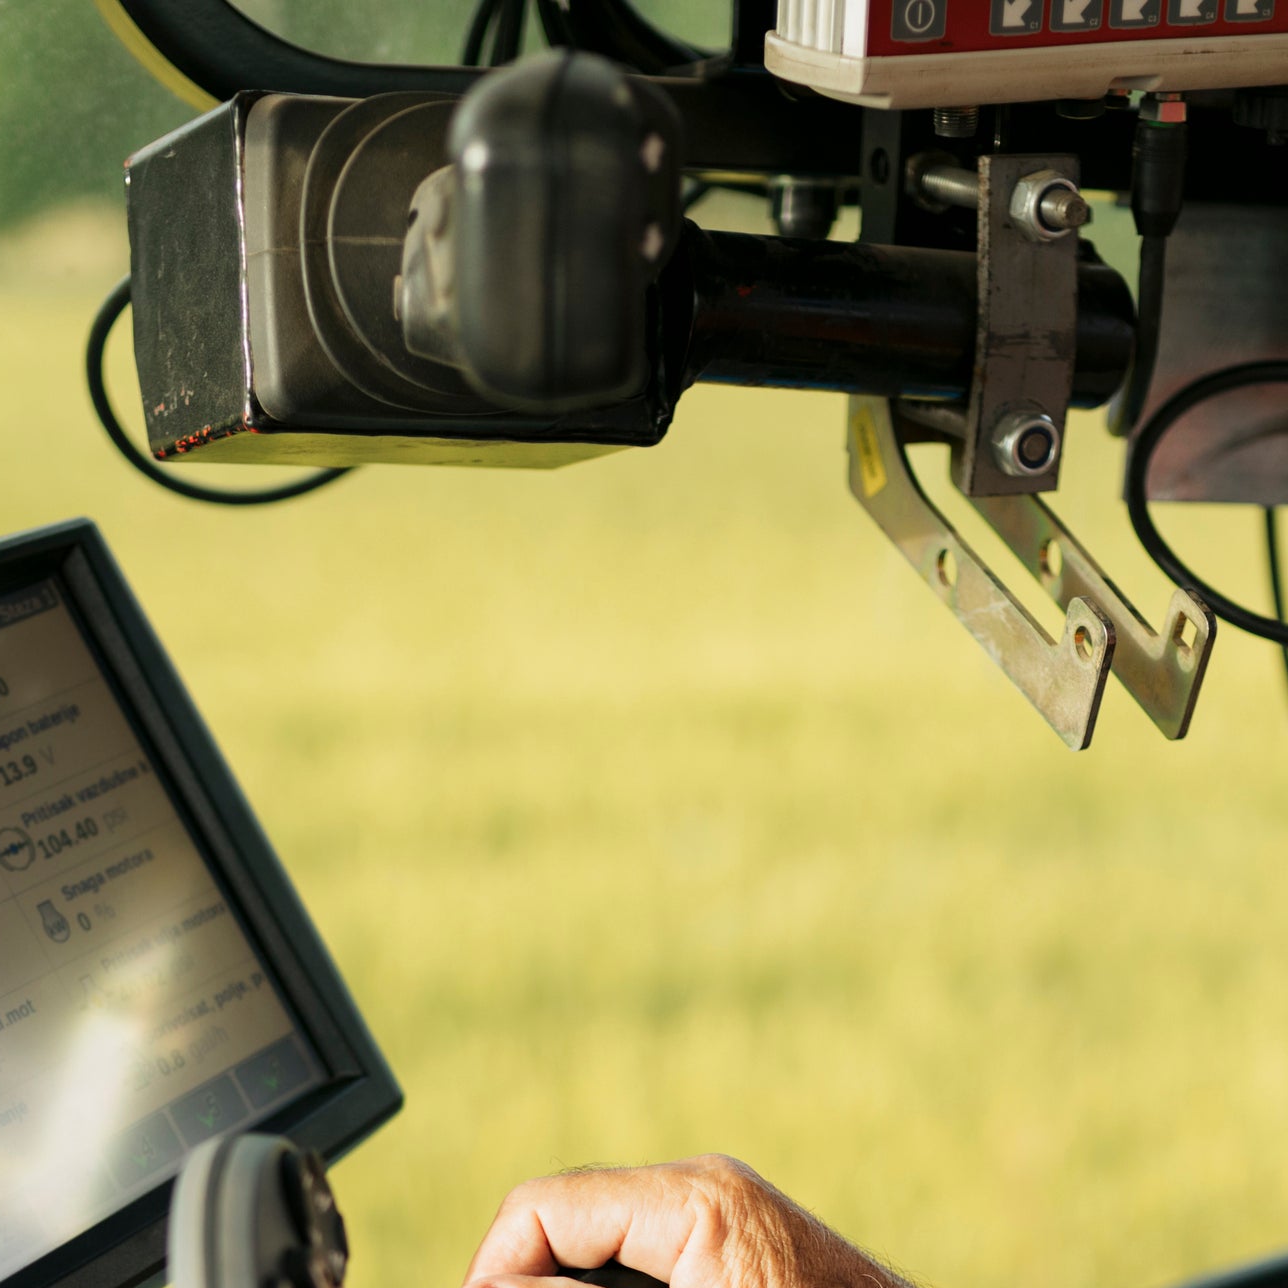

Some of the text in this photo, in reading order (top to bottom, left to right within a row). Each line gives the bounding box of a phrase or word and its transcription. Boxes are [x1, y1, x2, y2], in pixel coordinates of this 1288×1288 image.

[1029, 21, 1039, 30] C1
[1089, 17, 1099, 26] C2
[1147, 14, 1158, 24] C3
[26, 704, 80, 734] baterije
[21, 794, 75, 828] Pritisak
[37, 817, 98, 858] 104.40
[60, 849, 154, 901] Snaga motora
[76, 912, 91, 931] 0
